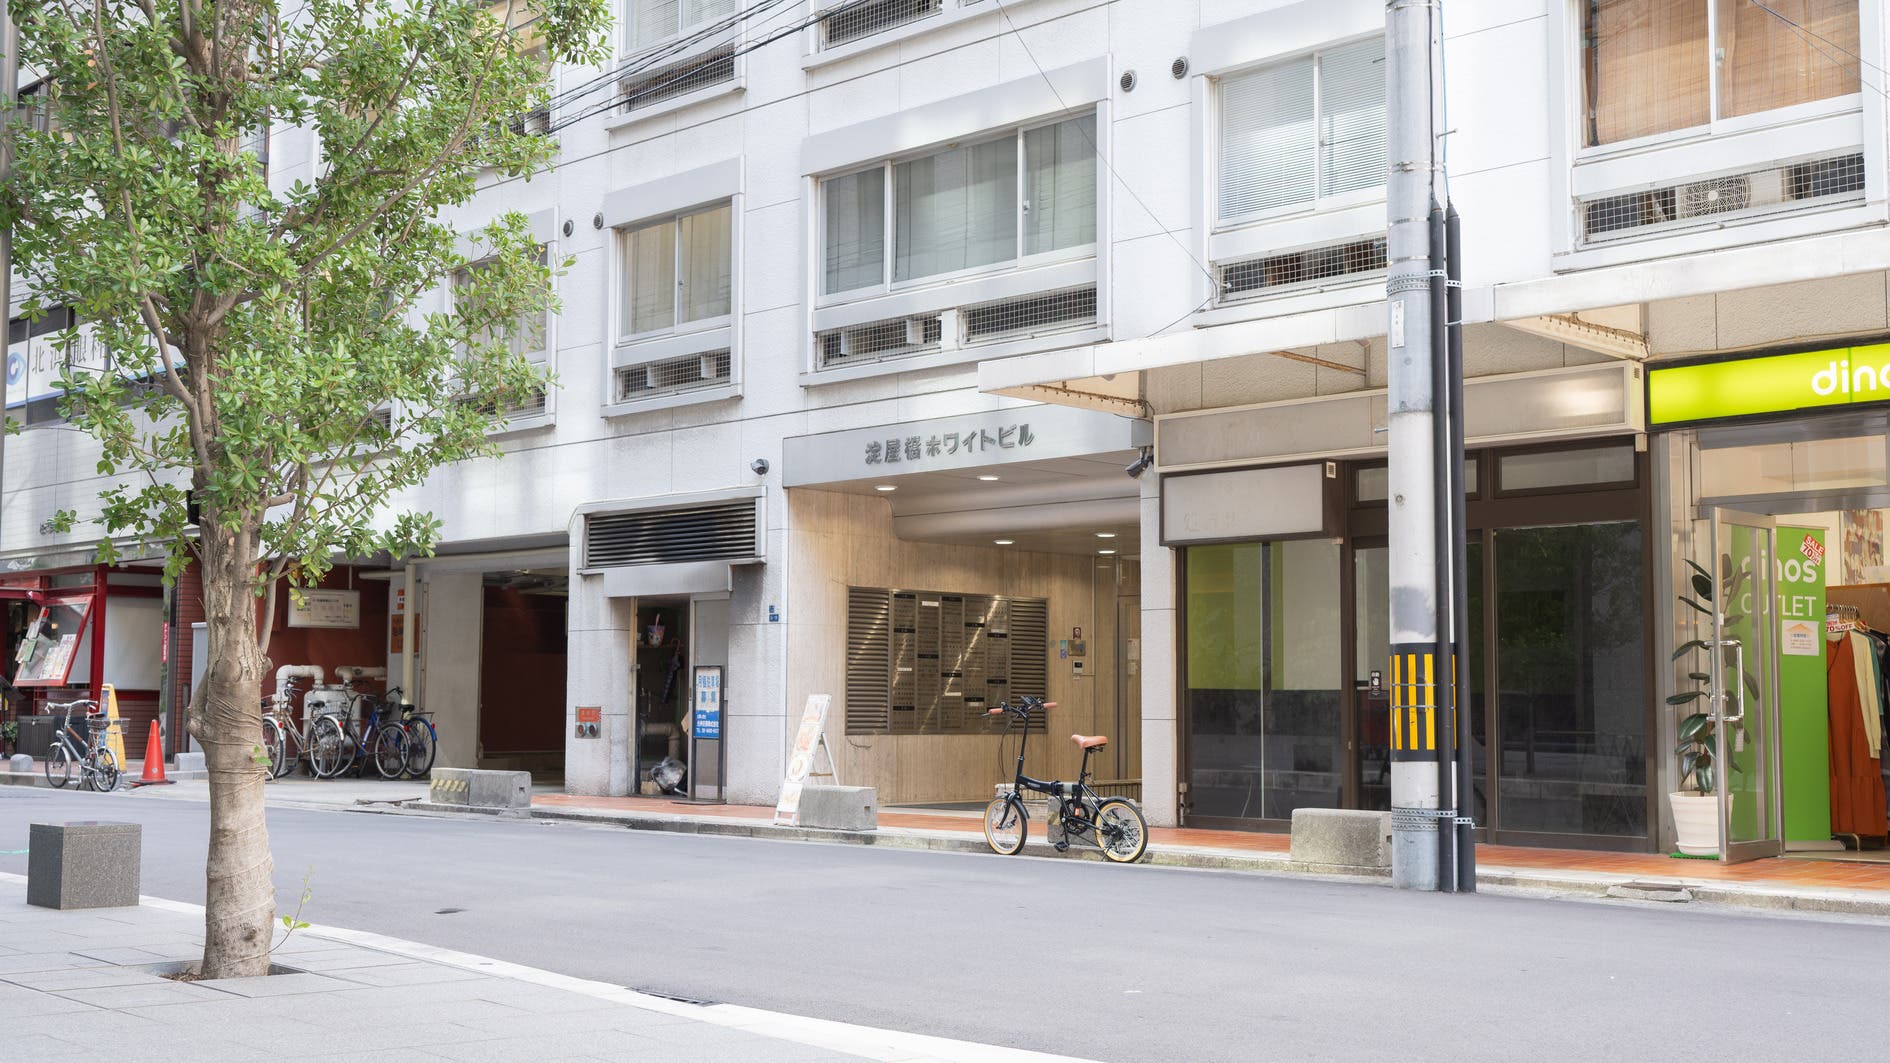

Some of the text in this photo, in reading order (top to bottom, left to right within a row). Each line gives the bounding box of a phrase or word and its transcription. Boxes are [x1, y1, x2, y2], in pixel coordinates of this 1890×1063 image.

[865, 424, 1035, 465] 淀屋橋ホワイトビル
[1805, 535, 1824, 555] SALE
[1741, 593, 1817, 617] OULET
